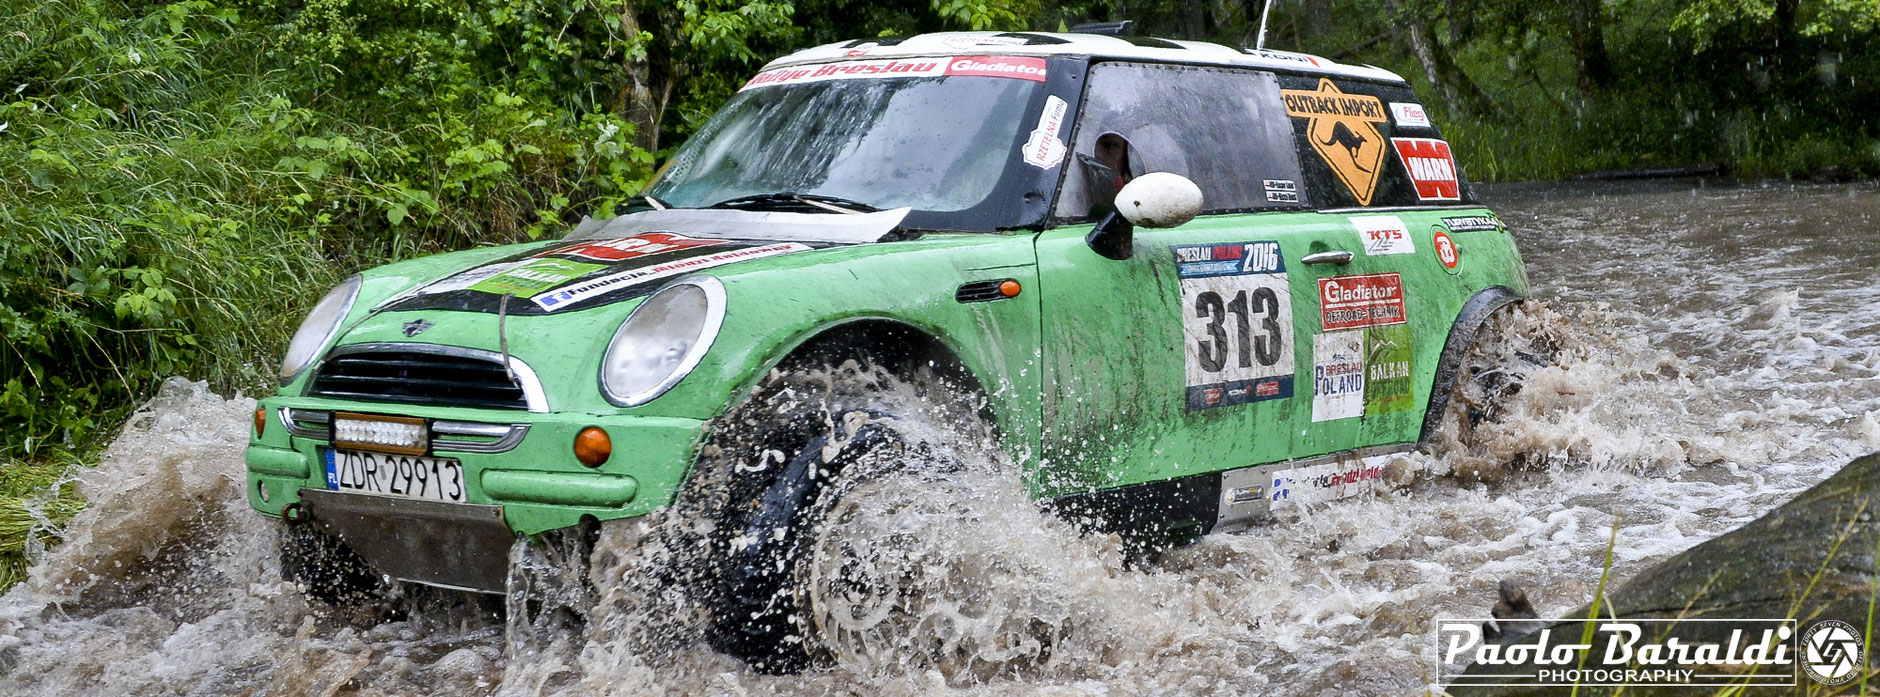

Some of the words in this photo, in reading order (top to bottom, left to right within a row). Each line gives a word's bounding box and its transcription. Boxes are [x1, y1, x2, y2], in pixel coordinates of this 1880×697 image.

[811, 61, 937, 78] Breslau
[1285, 94, 1341, 115] OUTBACK
[1339, 98, 1384, 118] IMPORT
[1036, 121, 1057, 161] RZETELNA
[1407, 156, 1455, 181] WARN
[1366, 229, 1402, 240] KTS
[1242, 242, 1279, 272] 2016
[1324, 280, 1397, 303] Gladiator
[1195, 286, 1282, 373] 313
[1314, 365, 1362, 396] POLAND
[1325, 361, 1363, 377] BRESLAU
[1370, 361, 1409, 381] BALKAN
[336, 449, 382, 492] ZDR
[385, 455, 462, 500] 29913
